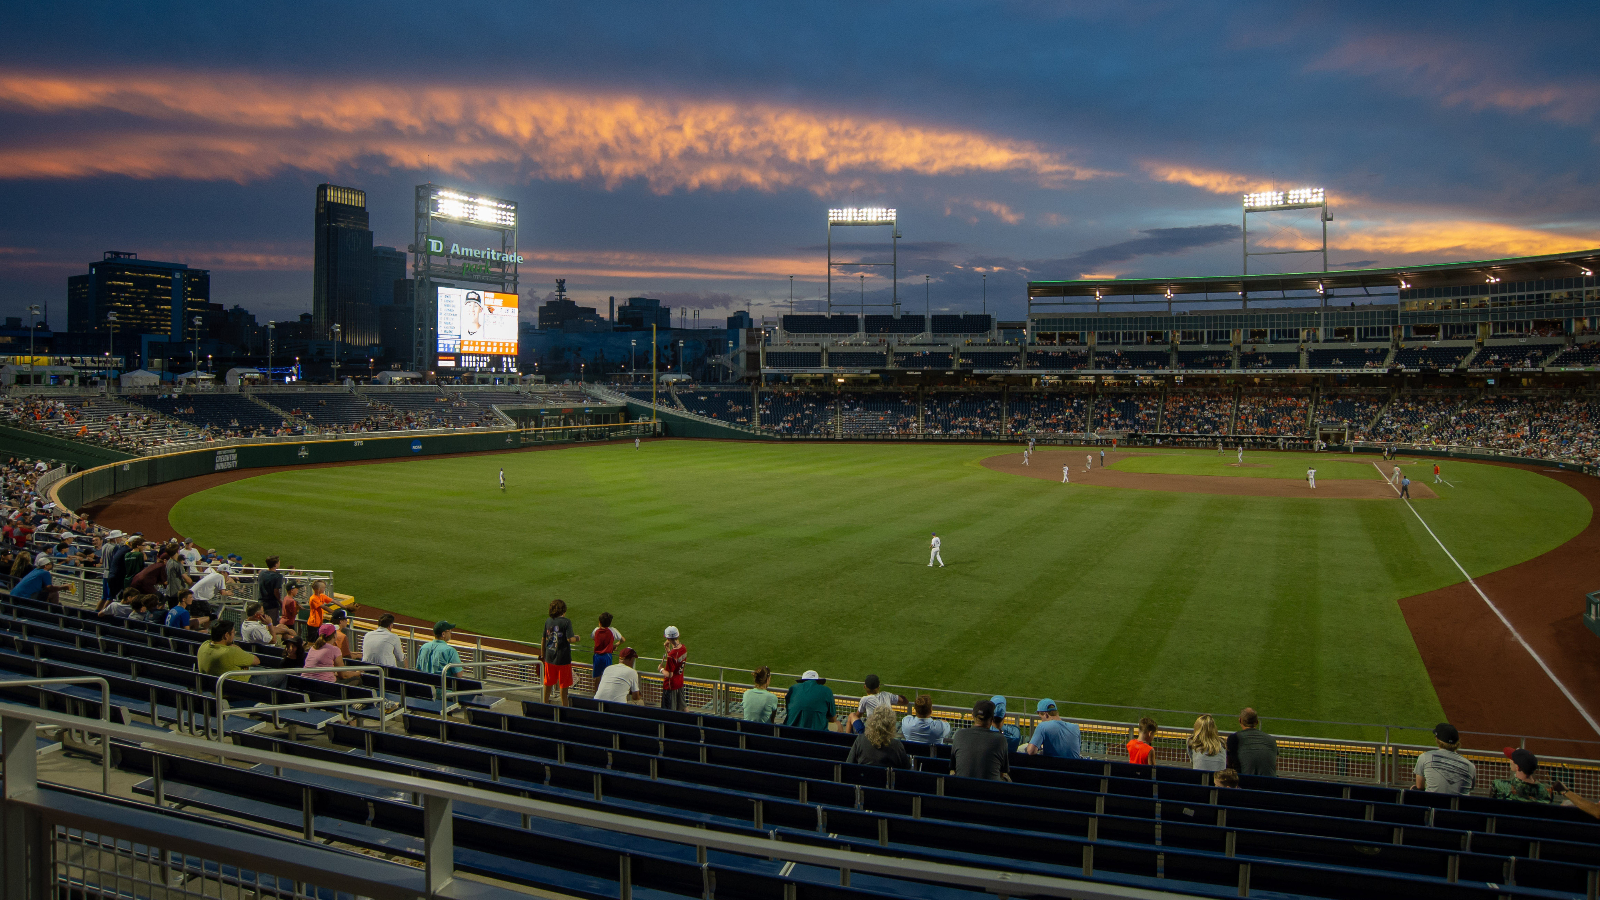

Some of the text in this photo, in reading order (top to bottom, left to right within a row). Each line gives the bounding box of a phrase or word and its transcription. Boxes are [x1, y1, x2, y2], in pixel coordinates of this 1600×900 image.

[428, 239, 524, 264] TD Ameritrade
[462, 259, 492, 276] park
